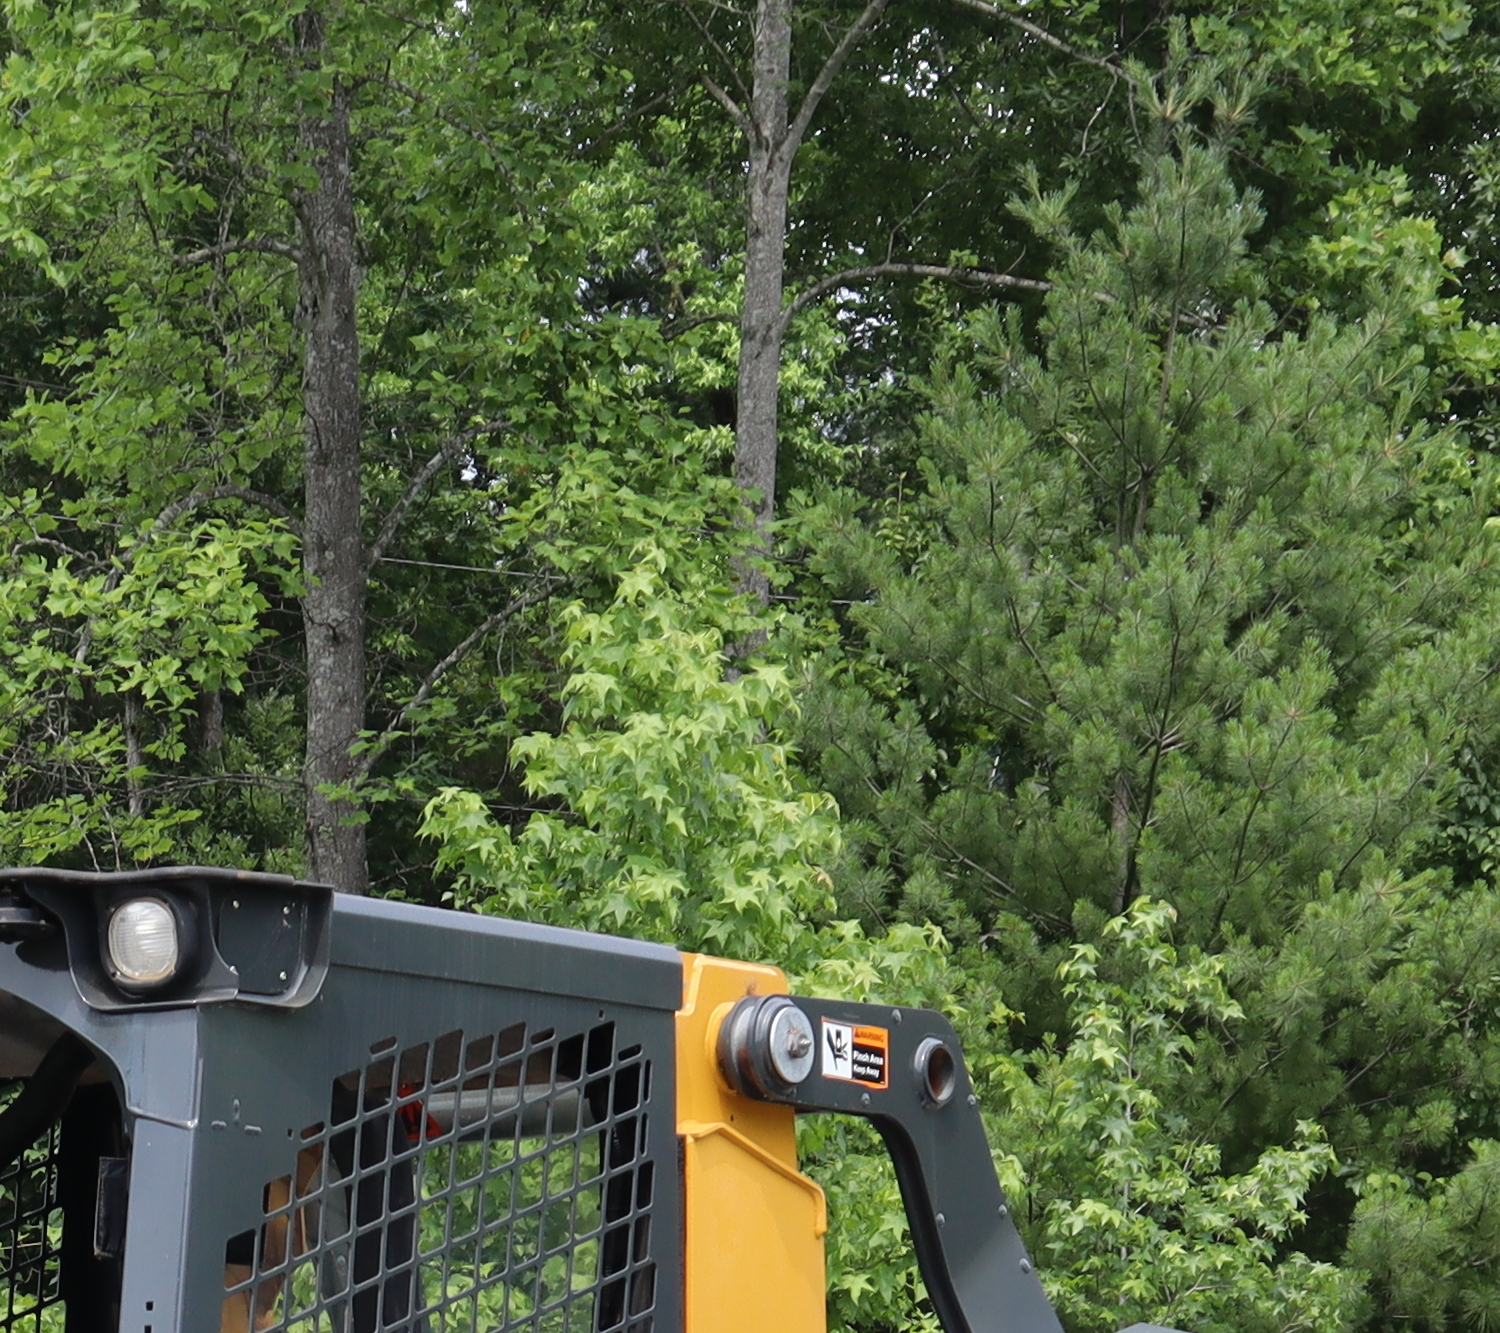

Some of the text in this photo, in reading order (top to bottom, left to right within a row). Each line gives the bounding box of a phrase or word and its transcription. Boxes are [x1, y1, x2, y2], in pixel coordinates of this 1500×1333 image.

[853, 1050, 884, 1066] Pinch Area
[853, 1063, 880, 1078] Keep Away
